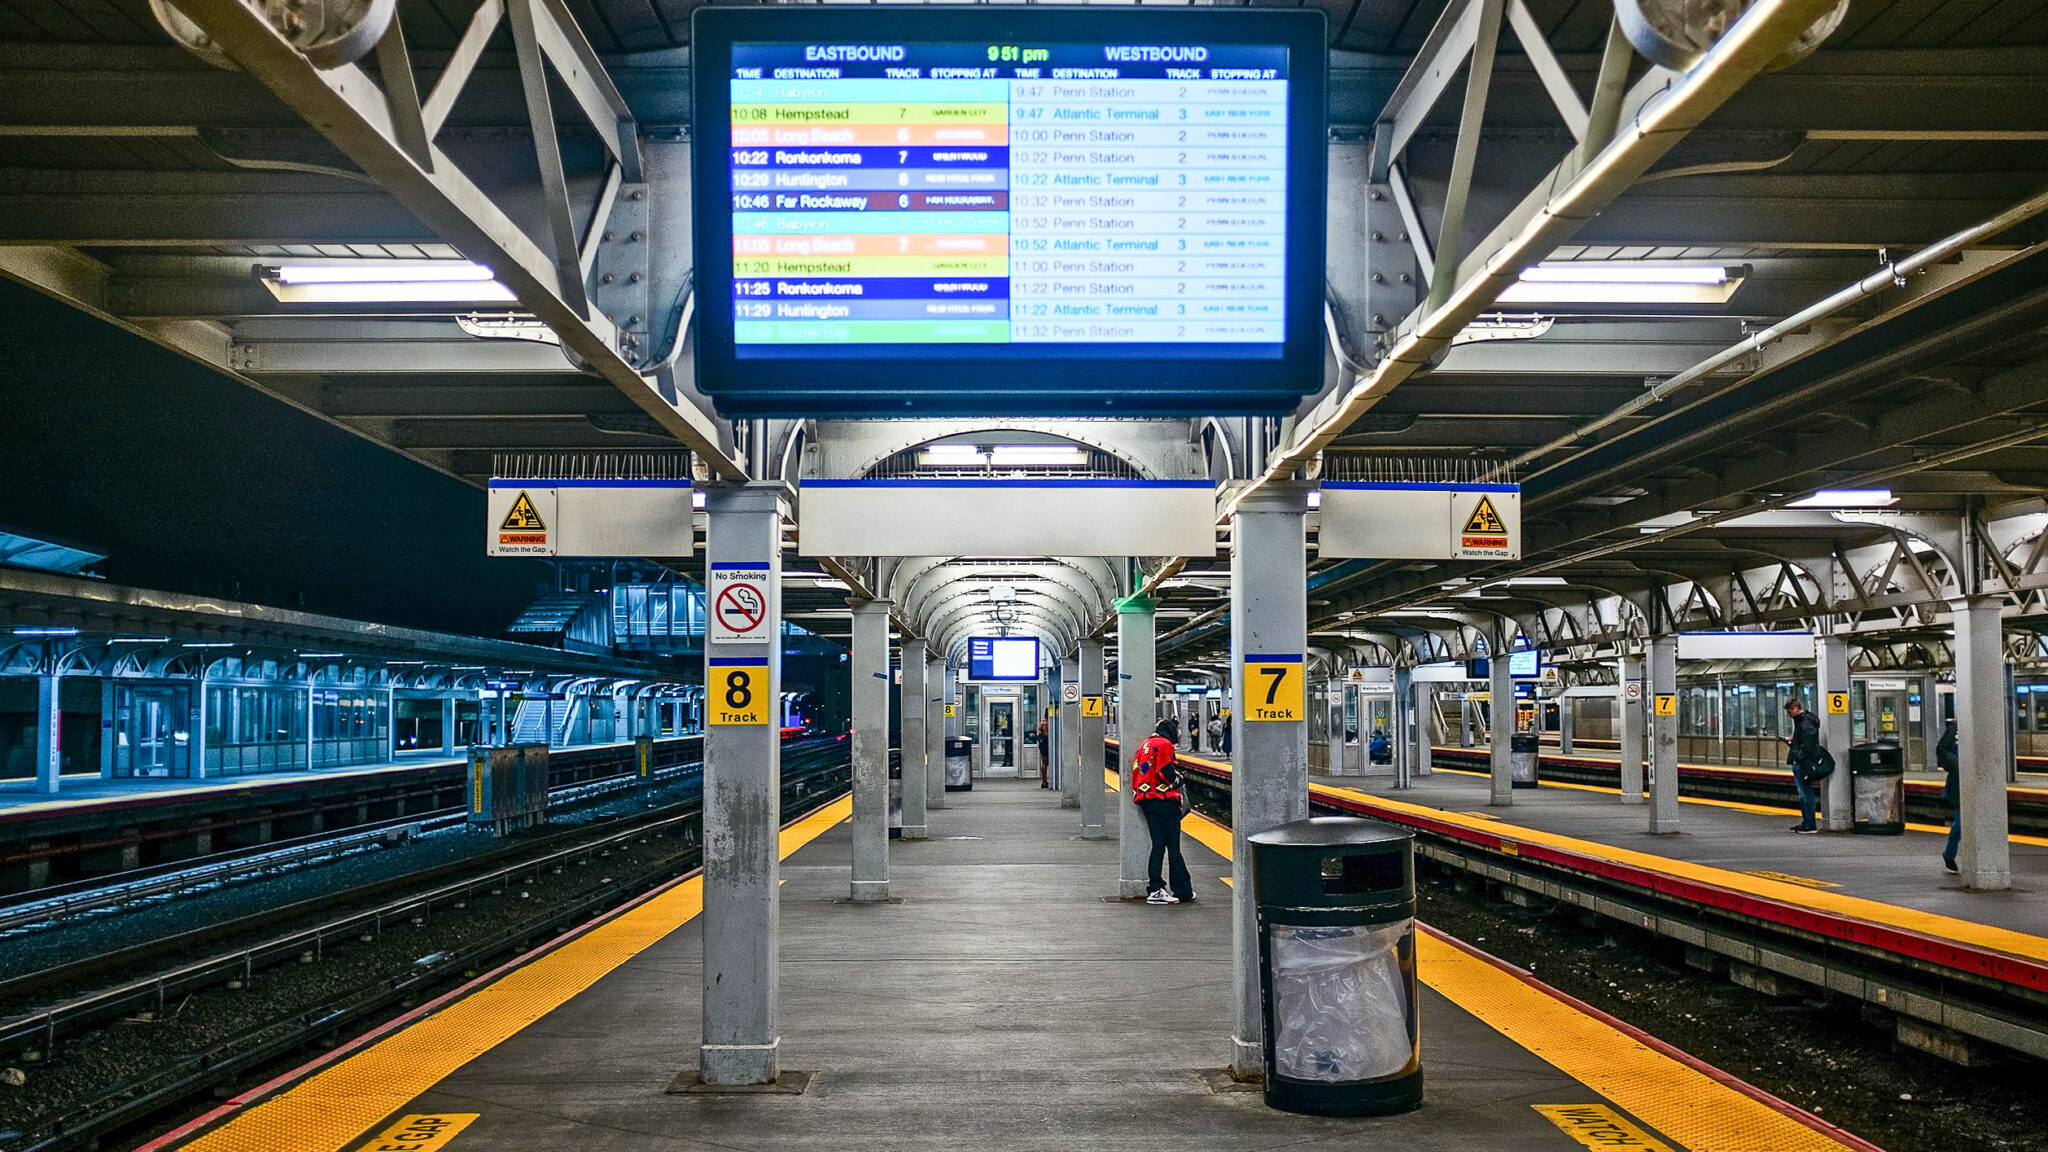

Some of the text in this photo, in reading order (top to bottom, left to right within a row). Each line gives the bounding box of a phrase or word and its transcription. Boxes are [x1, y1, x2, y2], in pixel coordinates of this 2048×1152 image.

[806, 46, 904, 61] EASTBOUND
[1022, 48, 1048, 64] pm
[1105, 46, 1207, 61] WESTBOUND
[736, 68, 760, 78] TIME
[774, 68, 840, 78] DESTINATION
[885, 68, 920, 78] TRACK
[930, 68, 997, 78] STOPPING AT
[1014, 68, 1040, 78] TIME
[1052, 68, 1117, 78] DESTINATION
[1166, 68, 1200, 79] TRACK
[1211, 69, 1276, 80] STOPPING AT
[1016, 87, 1044, 97] 9:47
[1054, 87, 1134, 97] Penn Station
[1179, 87, 1186, 97] 2
[734, 108, 767, 120] 10:08
[776, 108, 849, 122] Hempstead
[900, 108, 906, 120] 7
[1016, 108, 1044, 119] 9:47
[1053, 108, 1159, 119] Atlantic Terminal
[1179, 108, 1186, 119] 3
[775, 130, 852, 145] Long Beach
[1014, 130, 1048, 141] 10:00
[1054, 130, 1134, 141] Penn Station
[1179, 130, 1186, 141] 2
[733, 152, 768, 164] 10:22
[776, 152, 862, 164] Ronkonkoma
[899, 152, 908, 164] 7
[1014, 152, 1048, 163] 10:22
[1054, 152, 1134, 163] Penn Station
[1179, 152, 1186, 163] 2
[733, 173, 769, 186] 10:29
[776, 173, 848, 189] Huntington
[1014, 174, 1048, 185] 10:22
[1053, 174, 1159, 185] Atlantic Terminal
[1178, 174, 1186, 185] 3
[733, 195, 769, 208] 10:46
[776, 195, 868, 211] Far Rockaway
[1014, 196, 1048, 207] 10:32
[1054, 196, 1134, 207] Penn Station
[1178, 196, 1186, 207] 2
[777, 218, 829, 230] Babylon
[1014, 218, 1048, 229] 10:52
[1054, 218, 1134, 229] Penn Station
[1178, 218, 1186, 229] 2
[777, 240, 810, 254] Long
[899, 240, 908, 252] 7
[1014, 240, 1048, 250] 10:52
[1053, 240, 1158, 250] Atlantic Terminal
[1178, 240, 1186, 250] 3
[736, 262, 769, 272] 11:20
[778, 262, 850, 275] Hempstead
[1014, 262, 1048, 272] 11:00
[1054, 262, 1134, 272] Penn Station
[1178, 262, 1185, 272] 2
[735, 282, 770, 295] 11:25
[777, 282, 863, 295] Ronkonkoma
[1014, 283, 1048, 294] 11:22
[1054, 283, 1134, 294] Penn Station
[1178, 283, 1185, 294] 2
[735, 304, 771, 317] 11:29
[777, 304, 848, 319] Huntington
[1014, 304, 1048, 315] 11:22
[1053, 304, 1158, 315] Atlantic Terminal
[1178, 304, 1185, 315] 3
[1014, 326, 1048, 337] 11:32
[1054, 326, 1134, 337] Penn Station
[1177, 326, 1185, 337] 2
[730, 572, 766, 581] Smoking
[726, 670, 752, 709] 8
[1260, 668, 1287, 704] 7
[1088, 698, 1096, 711] 7
[1661, 698, 1669, 710] 7
[1833, 695, 1842, 708] 6
[945, 706, 951, 714] 8
[1256, 709, 1292, 718] Track
[720, 712, 757, 722] Track
[394, 1118, 452, 1142] GAP
[1556, 1108, 1644, 1145] WATCH
